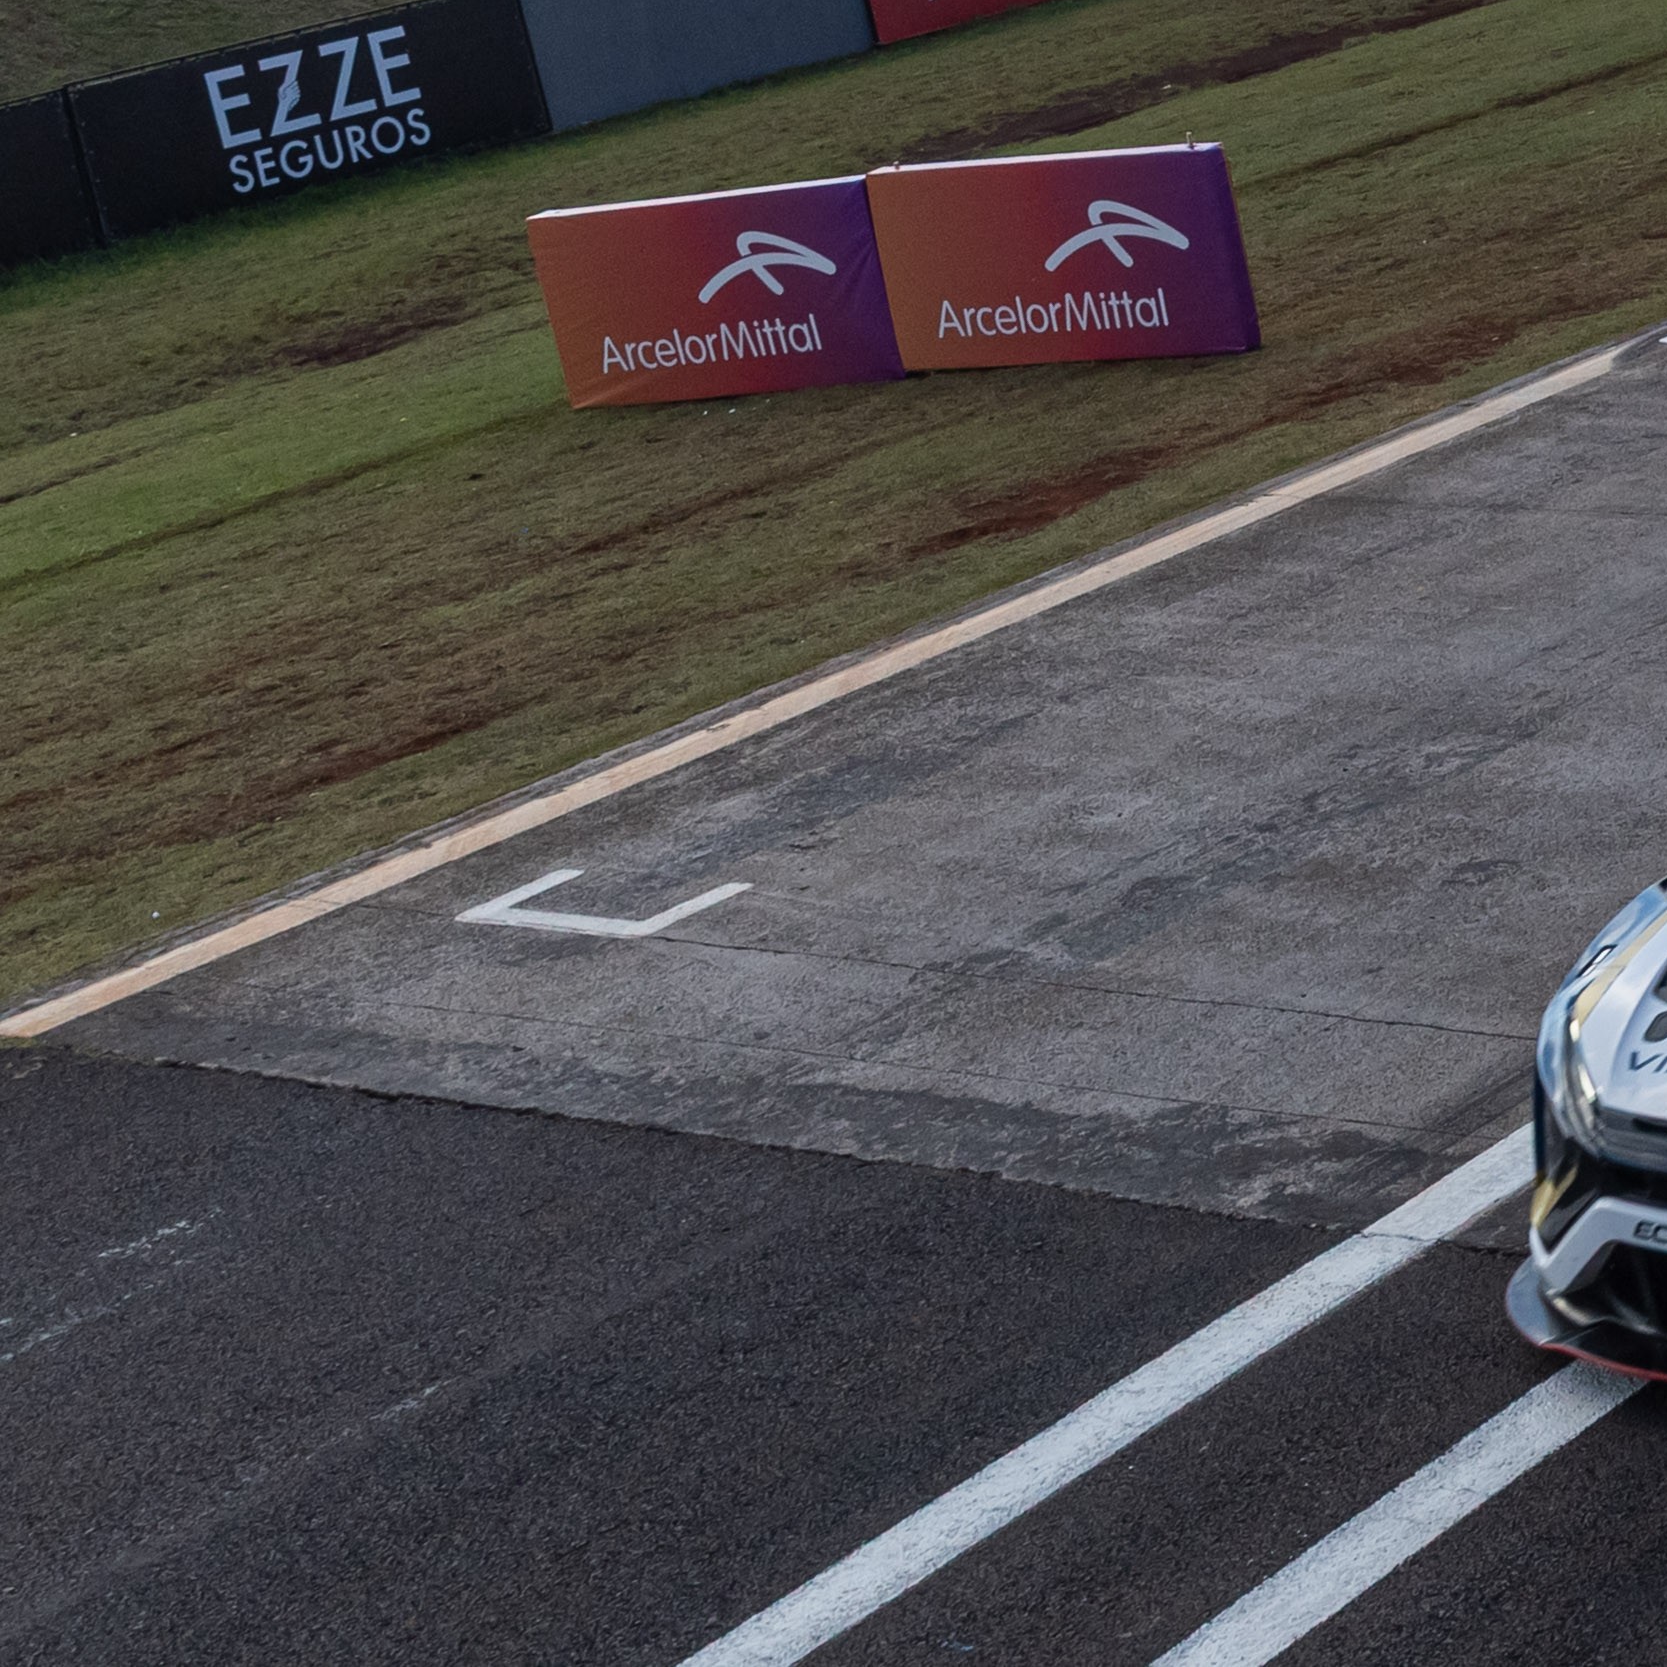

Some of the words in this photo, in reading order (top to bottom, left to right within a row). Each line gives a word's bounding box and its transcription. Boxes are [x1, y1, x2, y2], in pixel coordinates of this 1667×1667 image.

[203, 25, 422, 149] EZZE
[229, 108, 431, 193] SEGUROS
[601, 314, 823, 375] ArcelorMittal
[938, 288, 1170, 338] ArcelorMittal
